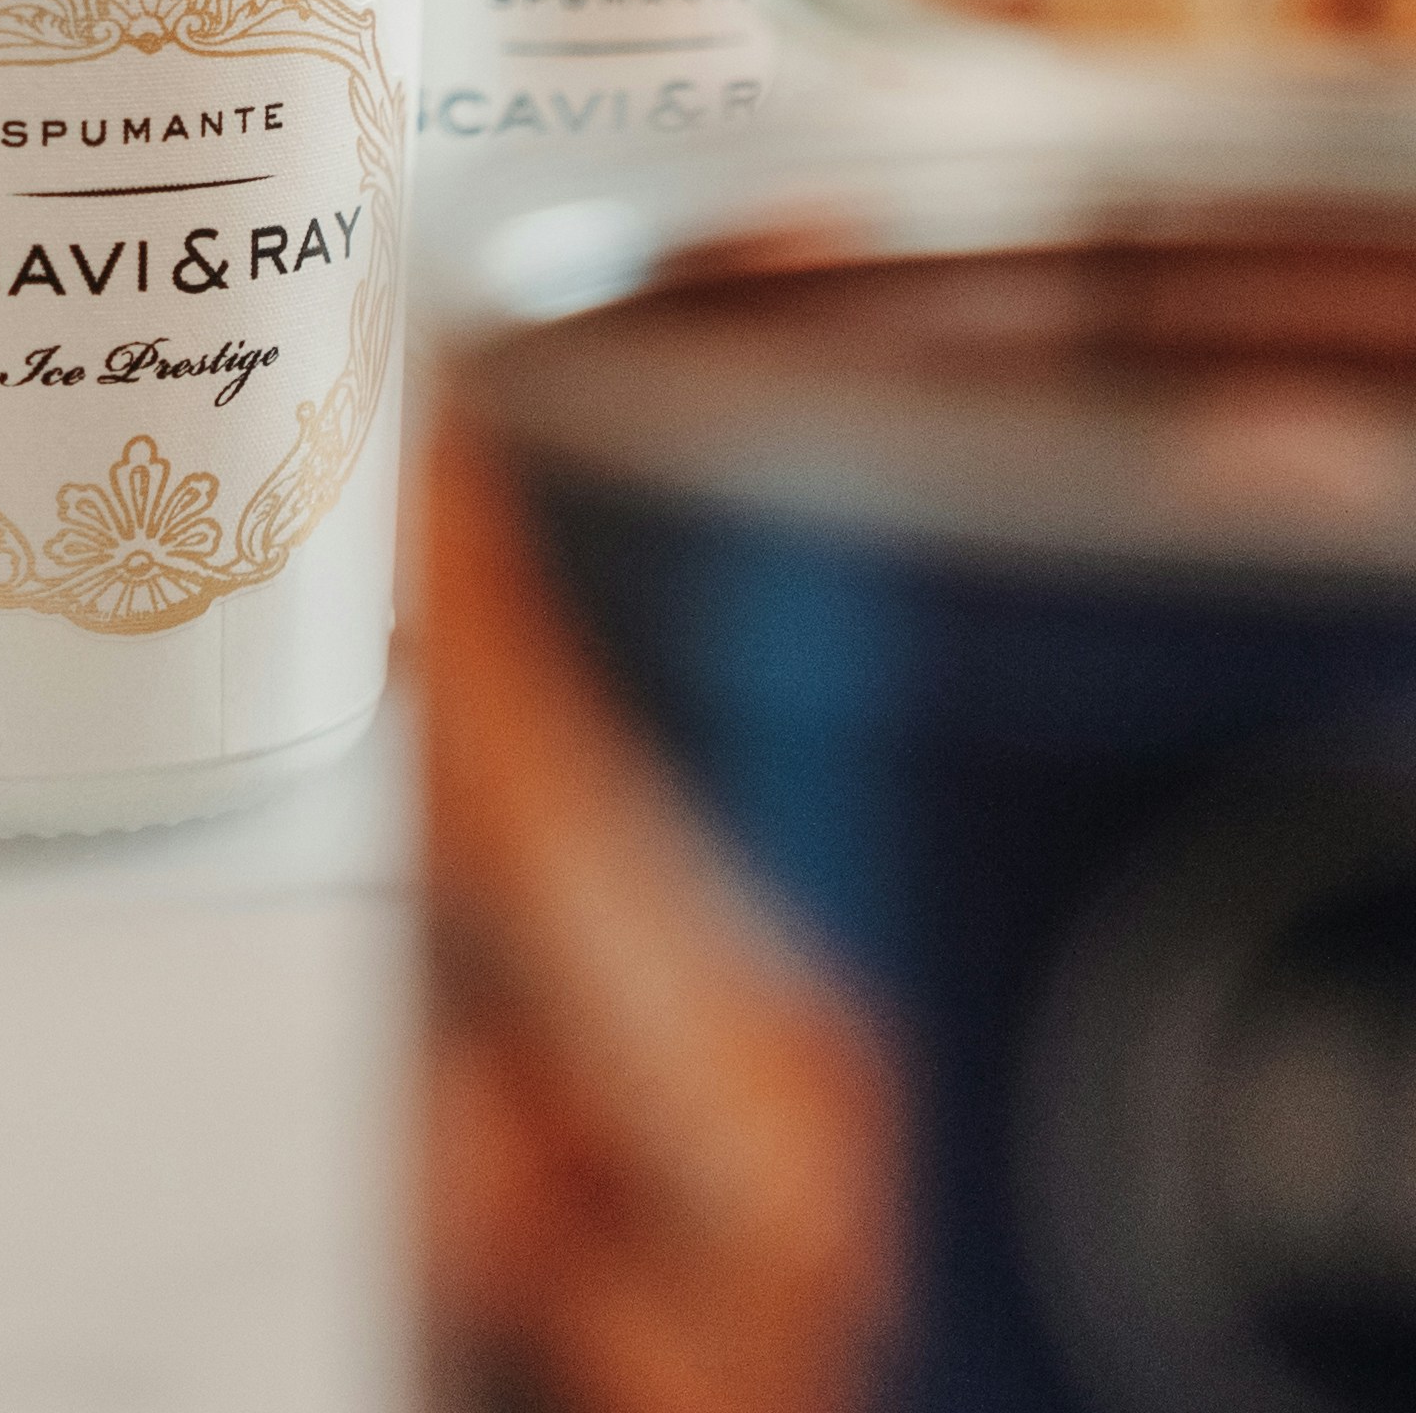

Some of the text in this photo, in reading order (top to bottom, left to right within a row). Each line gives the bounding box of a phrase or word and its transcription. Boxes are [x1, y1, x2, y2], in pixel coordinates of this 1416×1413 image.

[0, 102, 284, 149] SPUMANTE
[417, 85, 631, 136] CAVI
[171, 227, 230, 295] &
[249, 205, 362, 281] RAY
[96, 337, 280, 408] Prestige
